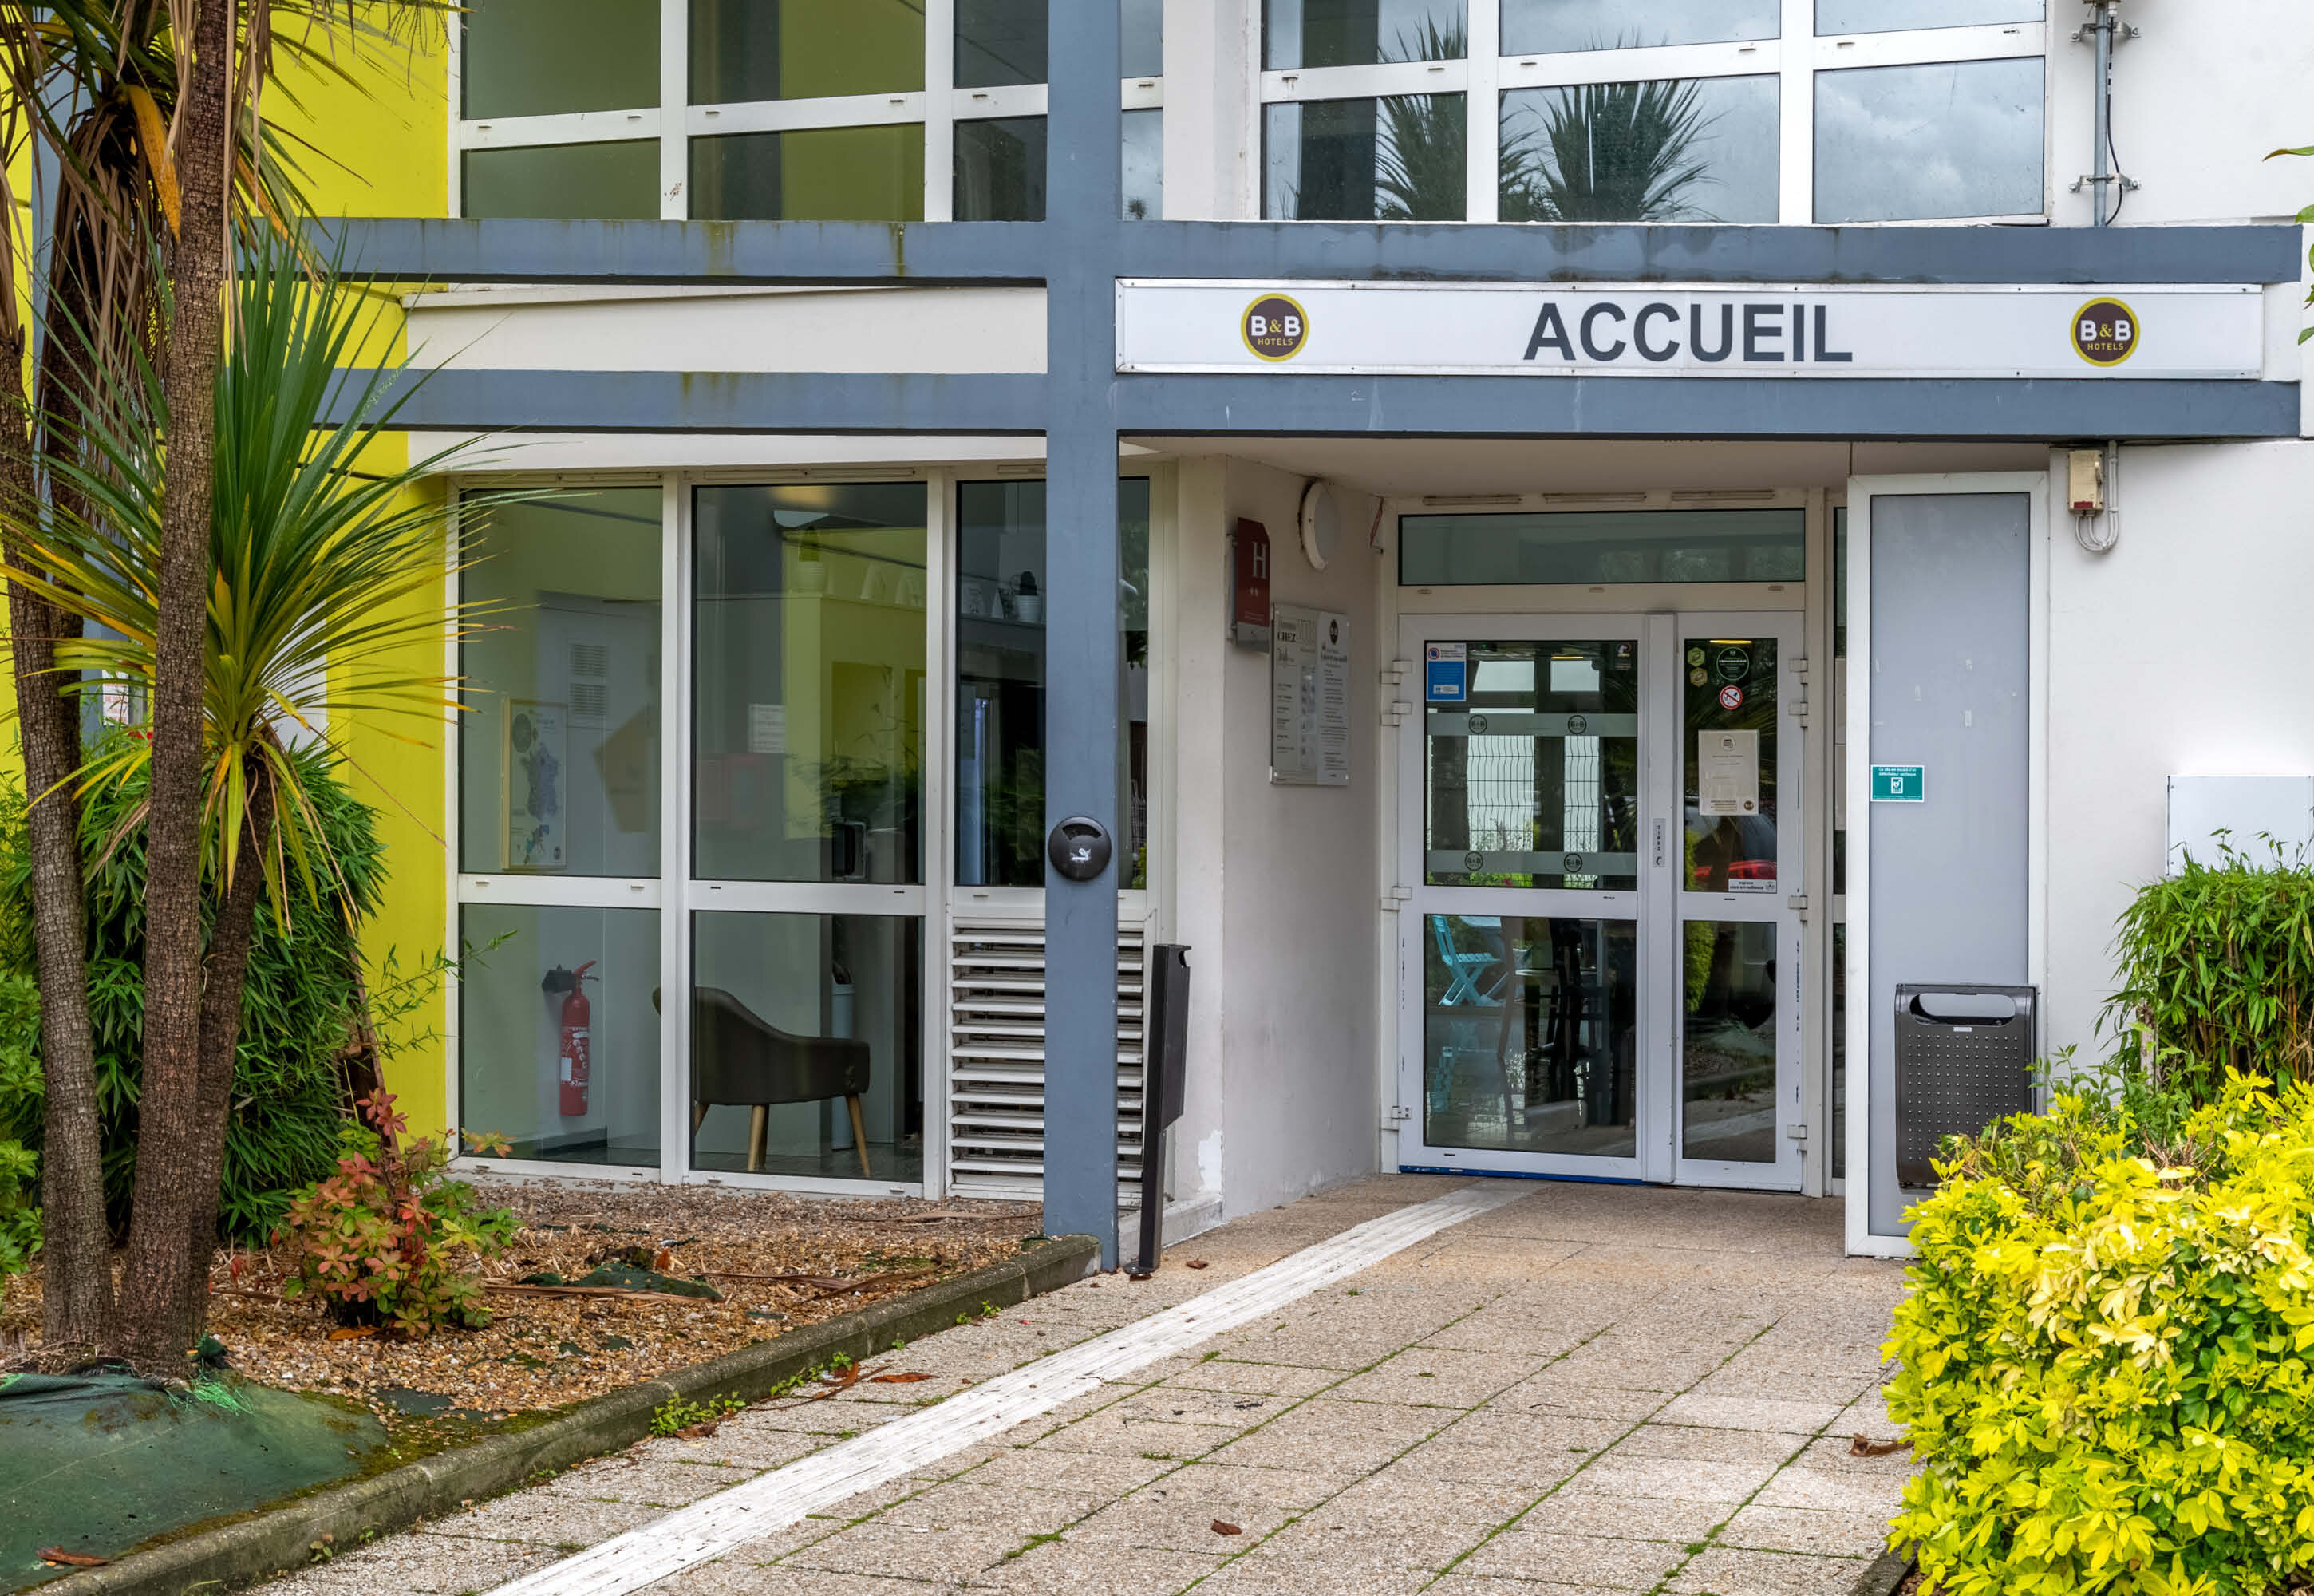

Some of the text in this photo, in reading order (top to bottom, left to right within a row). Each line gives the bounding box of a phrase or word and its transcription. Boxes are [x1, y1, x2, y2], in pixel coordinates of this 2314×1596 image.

[1250, 315, 1301, 337] B&B
[1522, 302, 1853, 362] ACCUEIL
[2080, 319, 2132, 342] B&B
[2087, 342, 2124, 351] HOTELS
[1252, 541, 1267, 580] H
